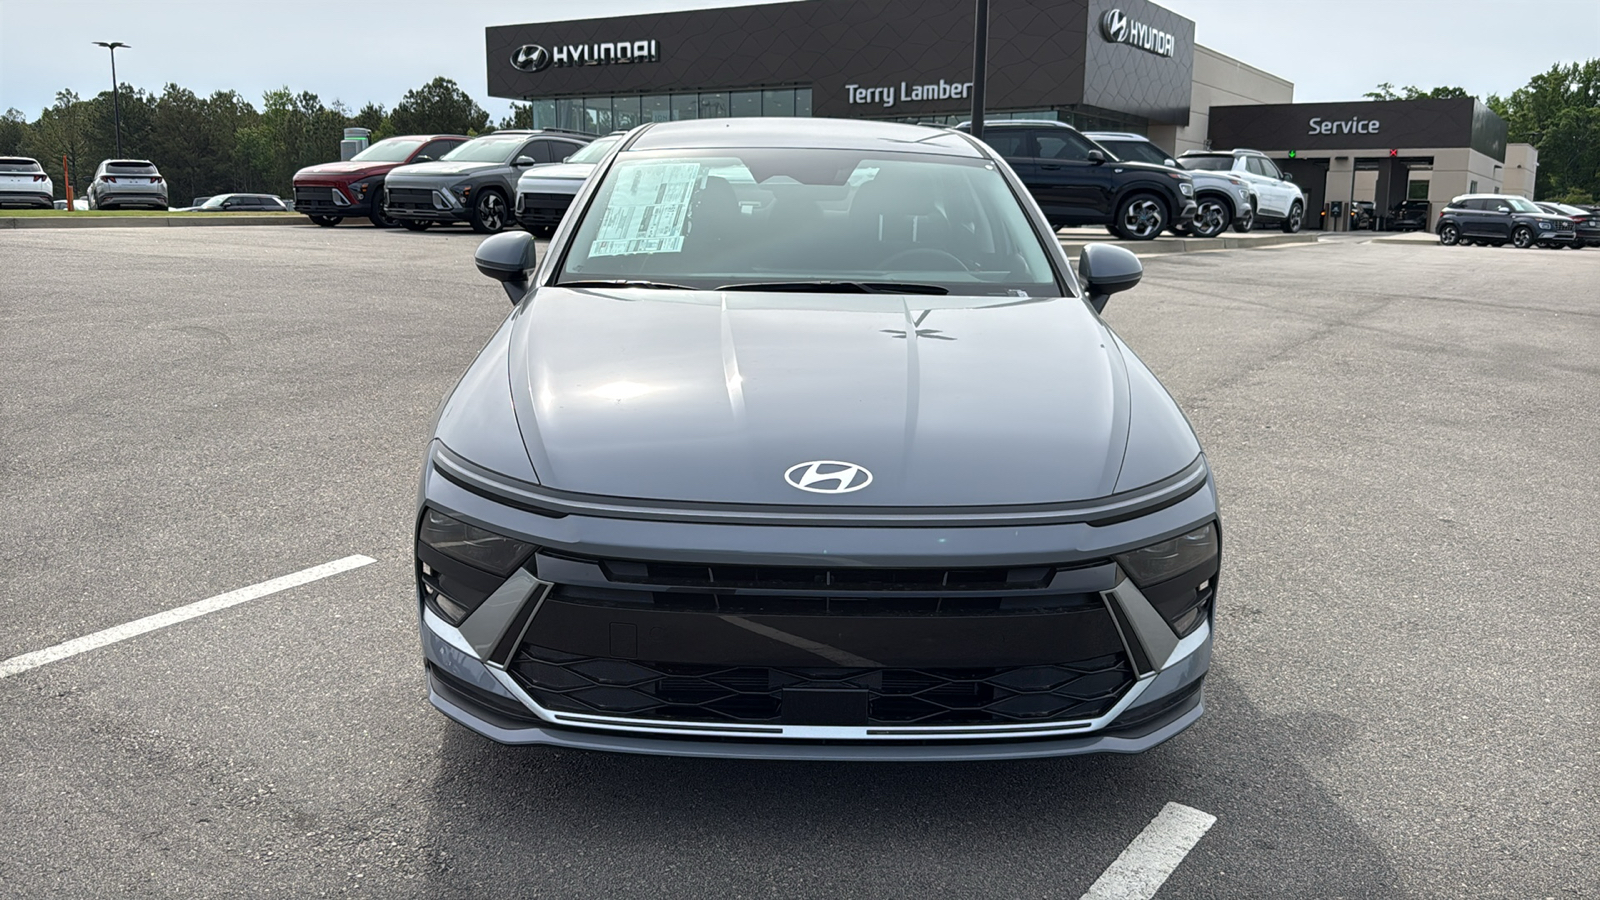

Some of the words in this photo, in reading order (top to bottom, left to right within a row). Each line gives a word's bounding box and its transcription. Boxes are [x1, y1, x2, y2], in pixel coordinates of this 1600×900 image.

[1129, 19, 1175, 57] HYUNDAI
[553, 39, 657, 67] HYUNDAI
[845, 84, 895, 107] Terry
[900, 79, 974, 102] Lamber
[1308, 116, 1380, 135] Service
